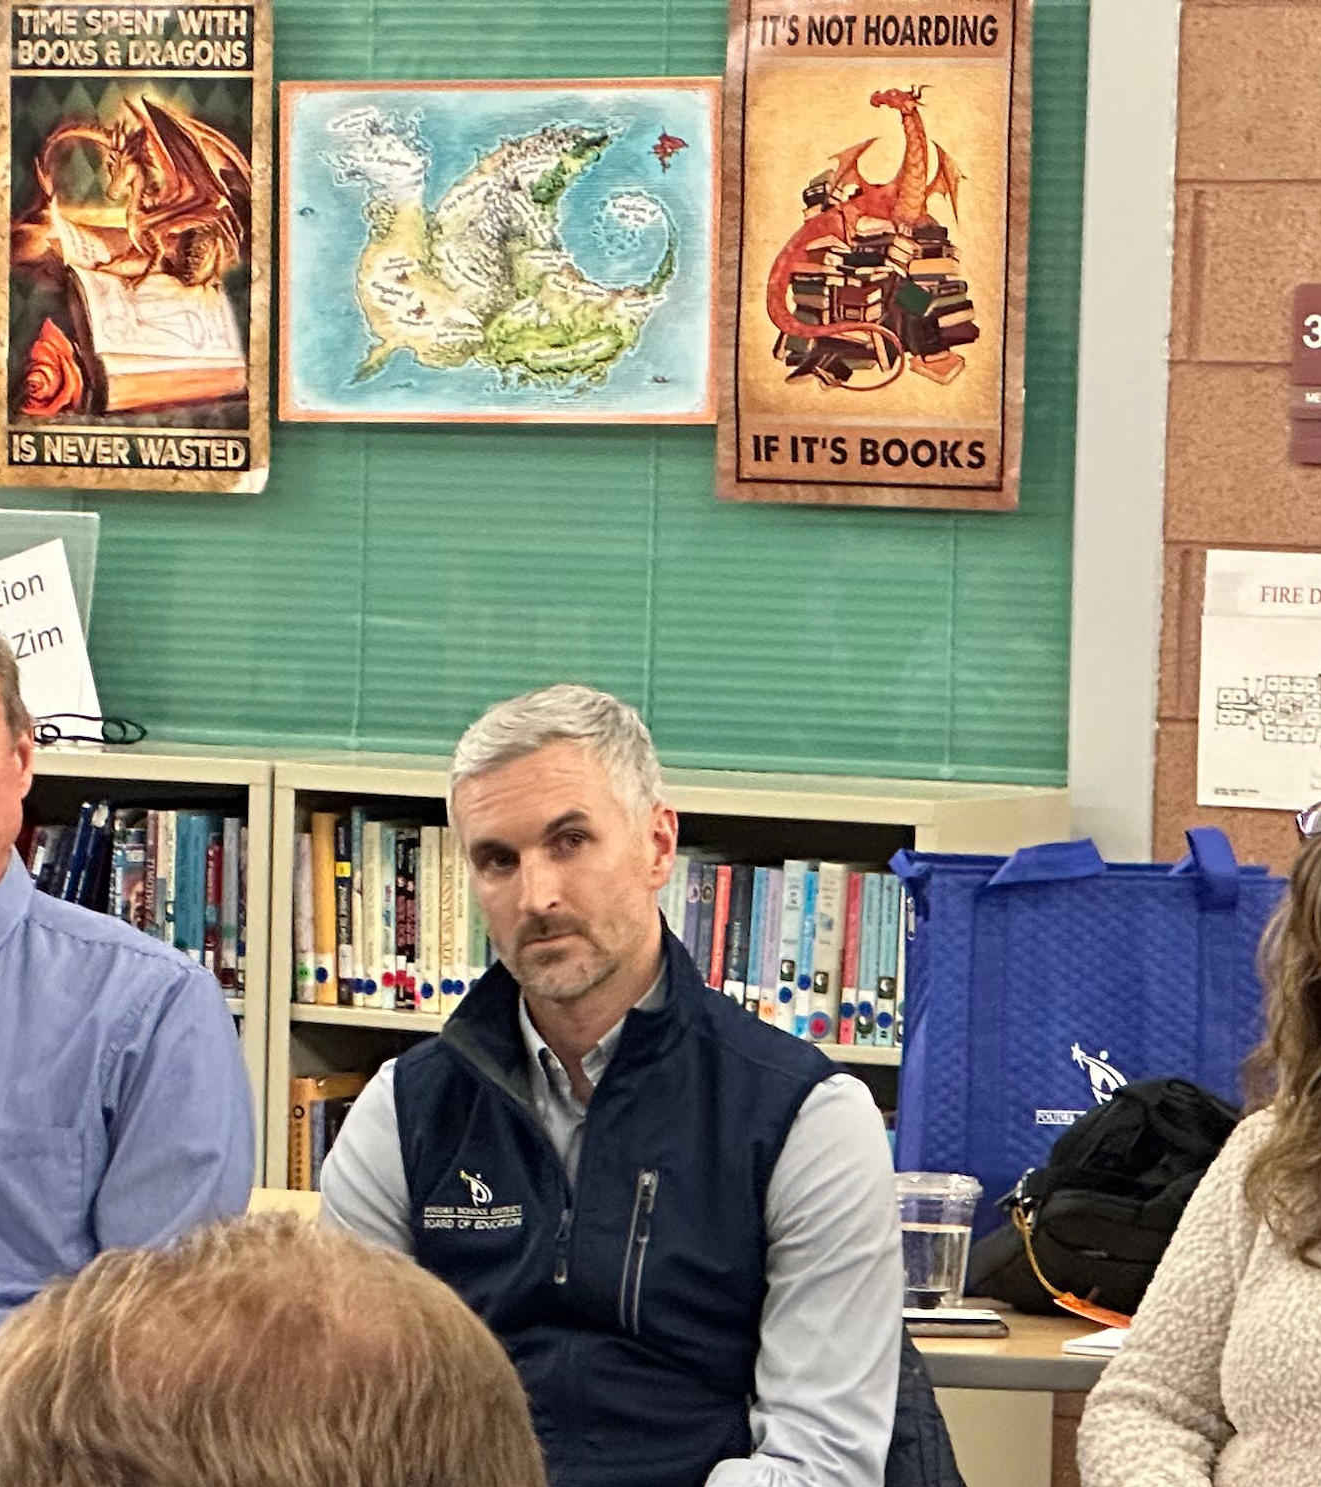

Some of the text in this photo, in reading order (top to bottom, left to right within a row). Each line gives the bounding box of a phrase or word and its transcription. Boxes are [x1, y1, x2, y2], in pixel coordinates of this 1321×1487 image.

[18, 9, 248, 37] TIME SPENT WITH
[760, 15, 999, 47] IT'S NOT HOARDING
[17, 40, 247, 68] BOOKS & DRAGONS
[12, 435, 246, 468] IS NEVER WASTED
[752, 434, 986, 470] IF IT'S BOOKS
[1259, 583, 1304, 606] FIRE
[11, 625, 64, 661] Zim
[424, 1217, 523, 1231] BOARD OF EDUCATION
